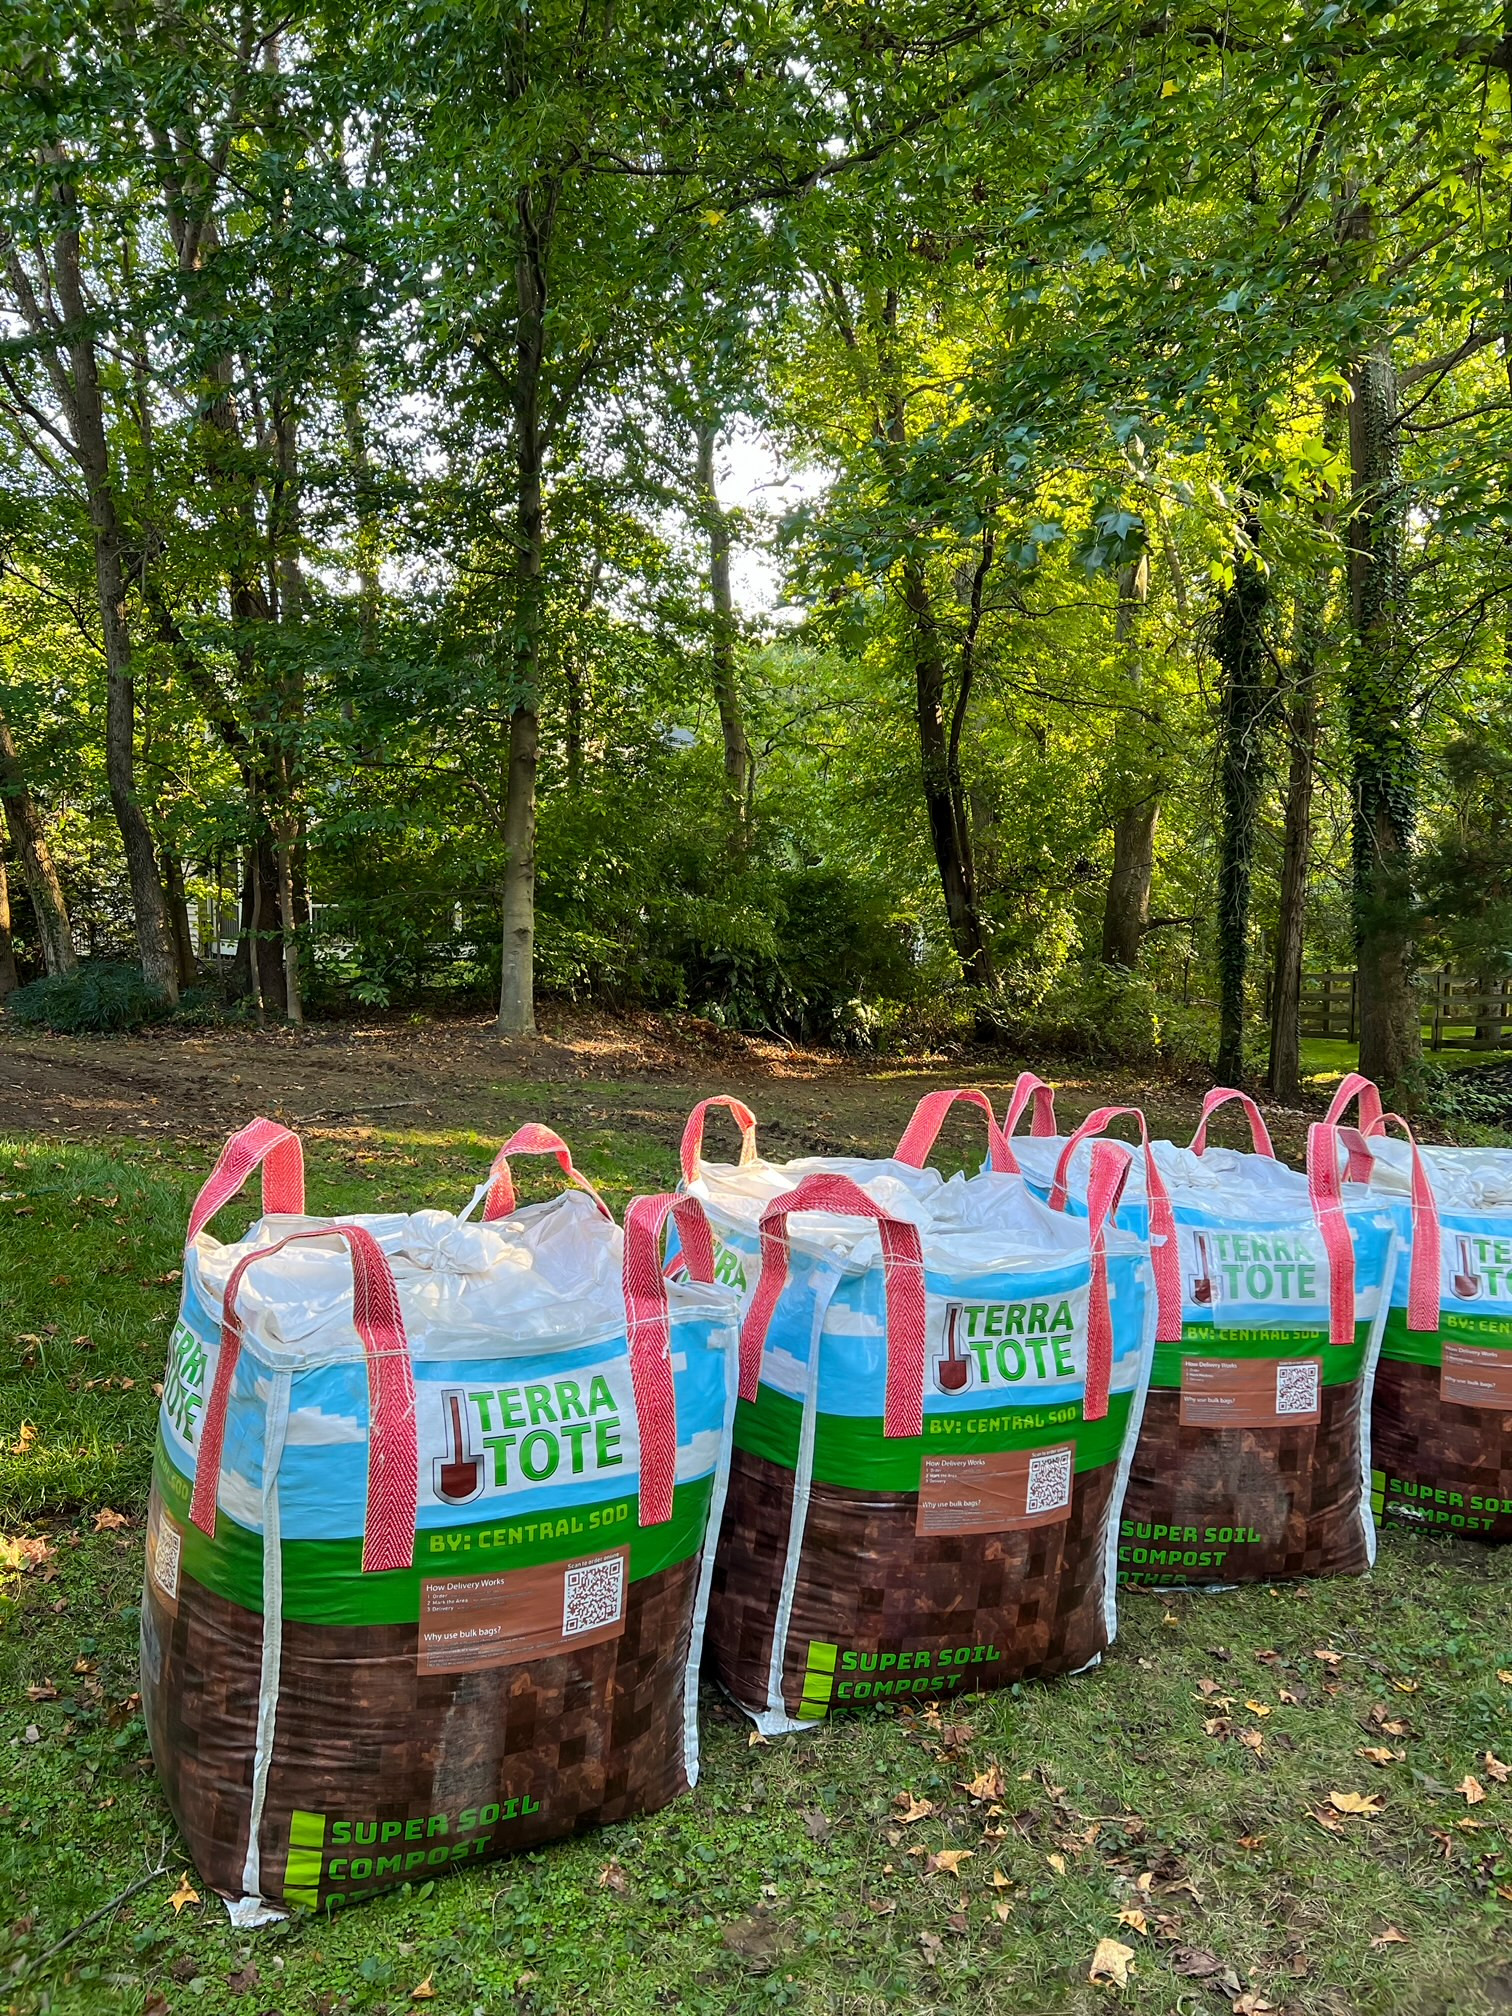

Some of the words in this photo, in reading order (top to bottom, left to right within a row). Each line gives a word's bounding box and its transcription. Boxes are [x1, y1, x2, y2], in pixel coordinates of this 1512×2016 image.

[1213, 1234, 1316, 1262] TERRA
[1222, 1264, 1317, 1299] TOTE
[964, 1300, 1075, 1337] TERRA
[1187, 1327, 1215, 1340] BY:
[1220, 1328, 1290, 1341] CENTRAL
[969, 1334, 1076, 1383] TOTE
[468, 1375, 618, 1432] TERRA
[930, 1419, 961, 1434] BY:
[967, 1414, 1045, 1433] CENTRAL
[1048, 1406, 1077, 1425] SOD
[483, 1416, 623, 1486] TOTE
[941, 1459, 967, 1468] Delivery
[922, 1501, 937, 1509] Why
[963, 1499, 981, 1508] bags?
[1389, 1478, 1464, 1508] SUPER
[430, 1534, 471, 1552] BY:
[479, 1517, 584, 1548] CENTRAL
[589, 1504, 629, 1529] SOD
[1120, 1520, 1198, 1543] SUPER
[1203, 1527, 1261, 1543] SOIL
[1118, 1546, 1227, 1567] COMPOST
[426, 1584, 445, 1592] How
[447, 1581, 480, 1591] Delivery
[480, 1578, 505, 1588] Works
[424, 1633, 442, 1642] Why
[444, 1632, 458, 1640] use
[459, 1629, 477, 1638] bulk
[478, 1625, 502, 1637] bags?
[841, 1651, 931, 1672] SUPER
[937, 1644, 1001, 1668] SOIL
[837, 1673, 961, 1699] COMPOST
[331, 1813, 449, 1845] SUPER
[457, 1794, 540, 1833] SOIL
[328, 1835, 492, 1880] COMPOST
